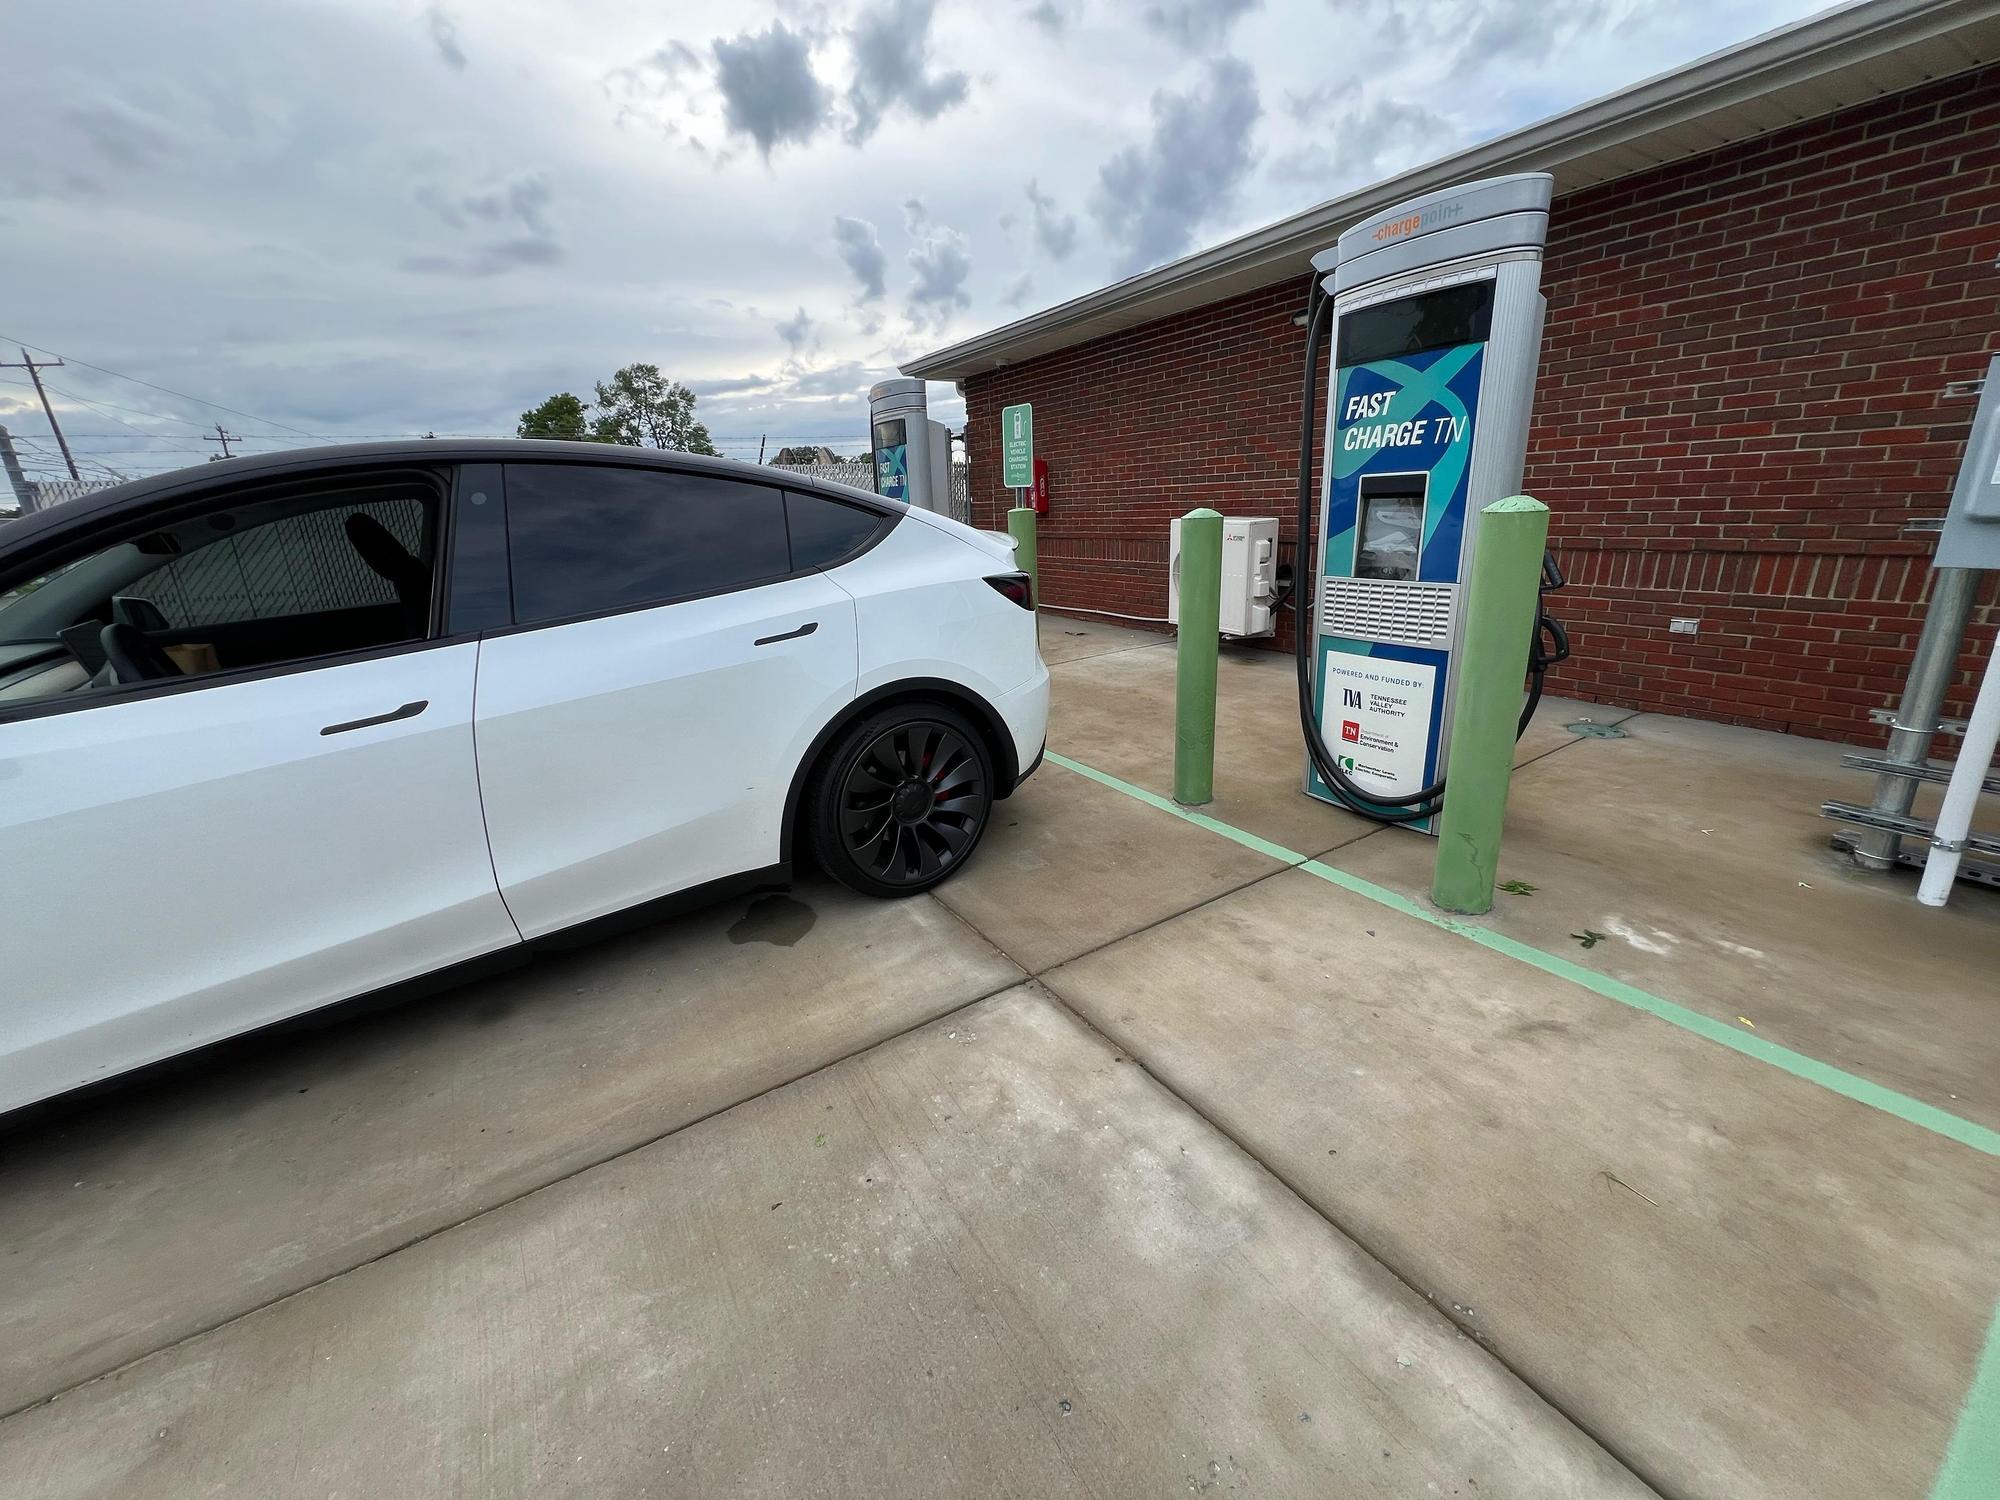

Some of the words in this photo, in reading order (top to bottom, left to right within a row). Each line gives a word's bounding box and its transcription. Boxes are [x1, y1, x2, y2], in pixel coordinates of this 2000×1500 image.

[1346, 390, 1397, 420] FAST
[1344, 419, 1428, 451] CHARGE
[1433, 415, 1468, 445] TN
[879, 461, 890, 473] FAST
[1010, 462, 1026, 470] STATION
[881, 475, 899, 488] CHARGE
[1332, 667, 1362, 679] POWERED
[1365, 673, 1380, 682] AND
[1381, 675, 1411, 687] FUNDED
[1413, 680, 1425, 689] BY:
[1343, 688, 1362, 710] TVA
[1370, 693, 1408, 706] TENNESSEE
[1370, 700, 1393, 709] VALLEY
[1369, 706, 1405, 718] AUTHORITY
[1344, 725, 1356, 736] TN
[1359, 740, 1395, 753] Conservation
[1360, 734, 1393, 747] Environment
